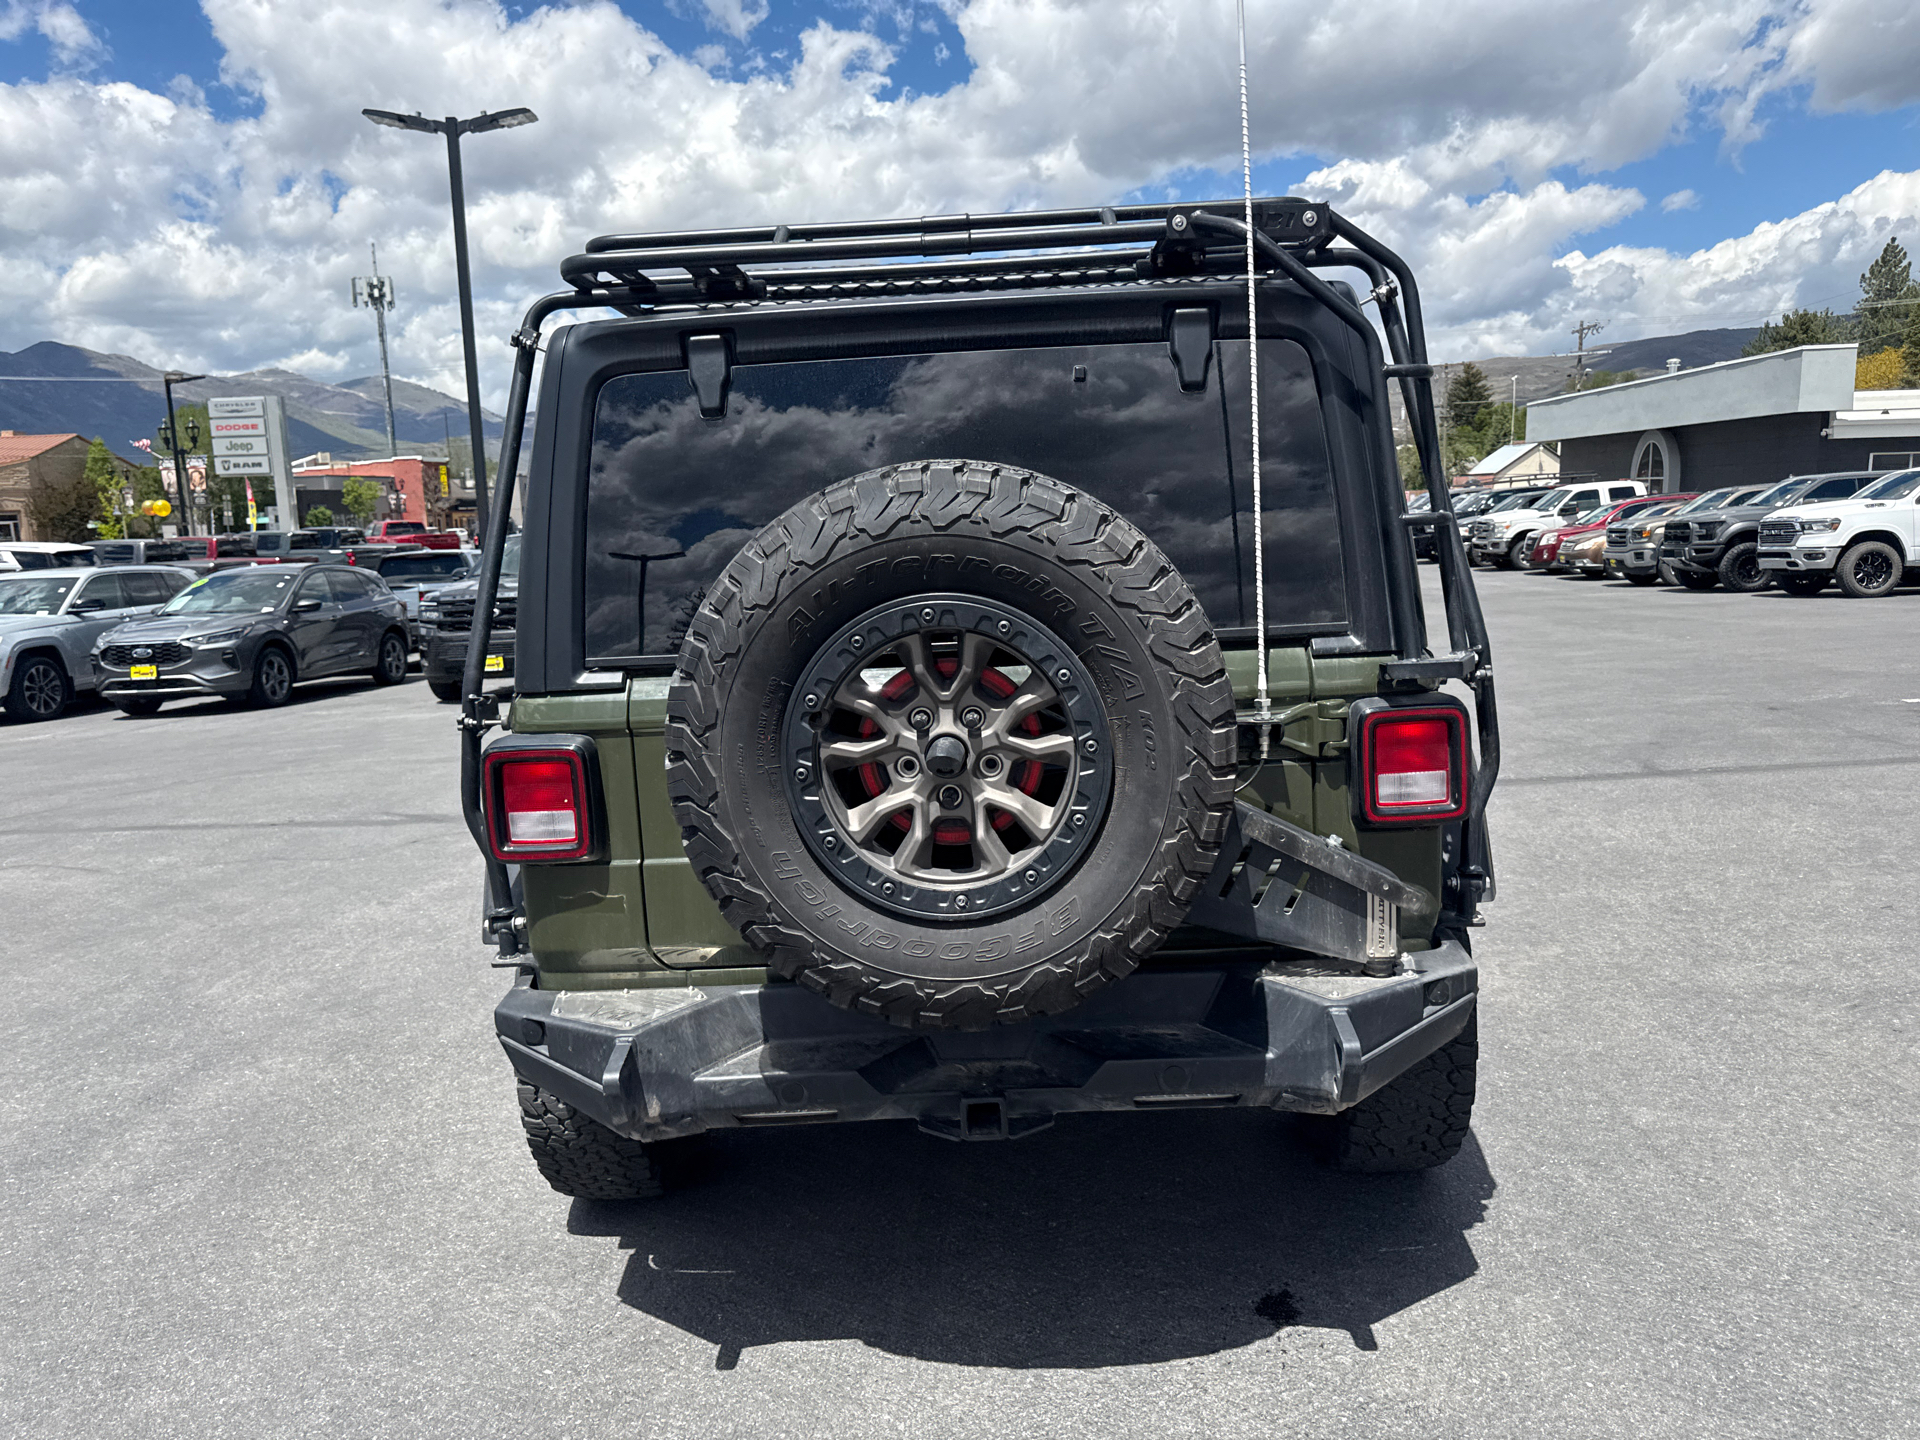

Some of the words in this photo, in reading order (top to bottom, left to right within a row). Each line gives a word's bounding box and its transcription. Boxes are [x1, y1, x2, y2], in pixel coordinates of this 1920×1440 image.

[215, 423, 259, 431] DODGE
[225, 440, 253, 452] Jeep
[787, 553, 1077, 647] All-Terrain
[1079, 611, 1145, 702] T/A
[771, 851, 1083, 962] BFGoodrich
